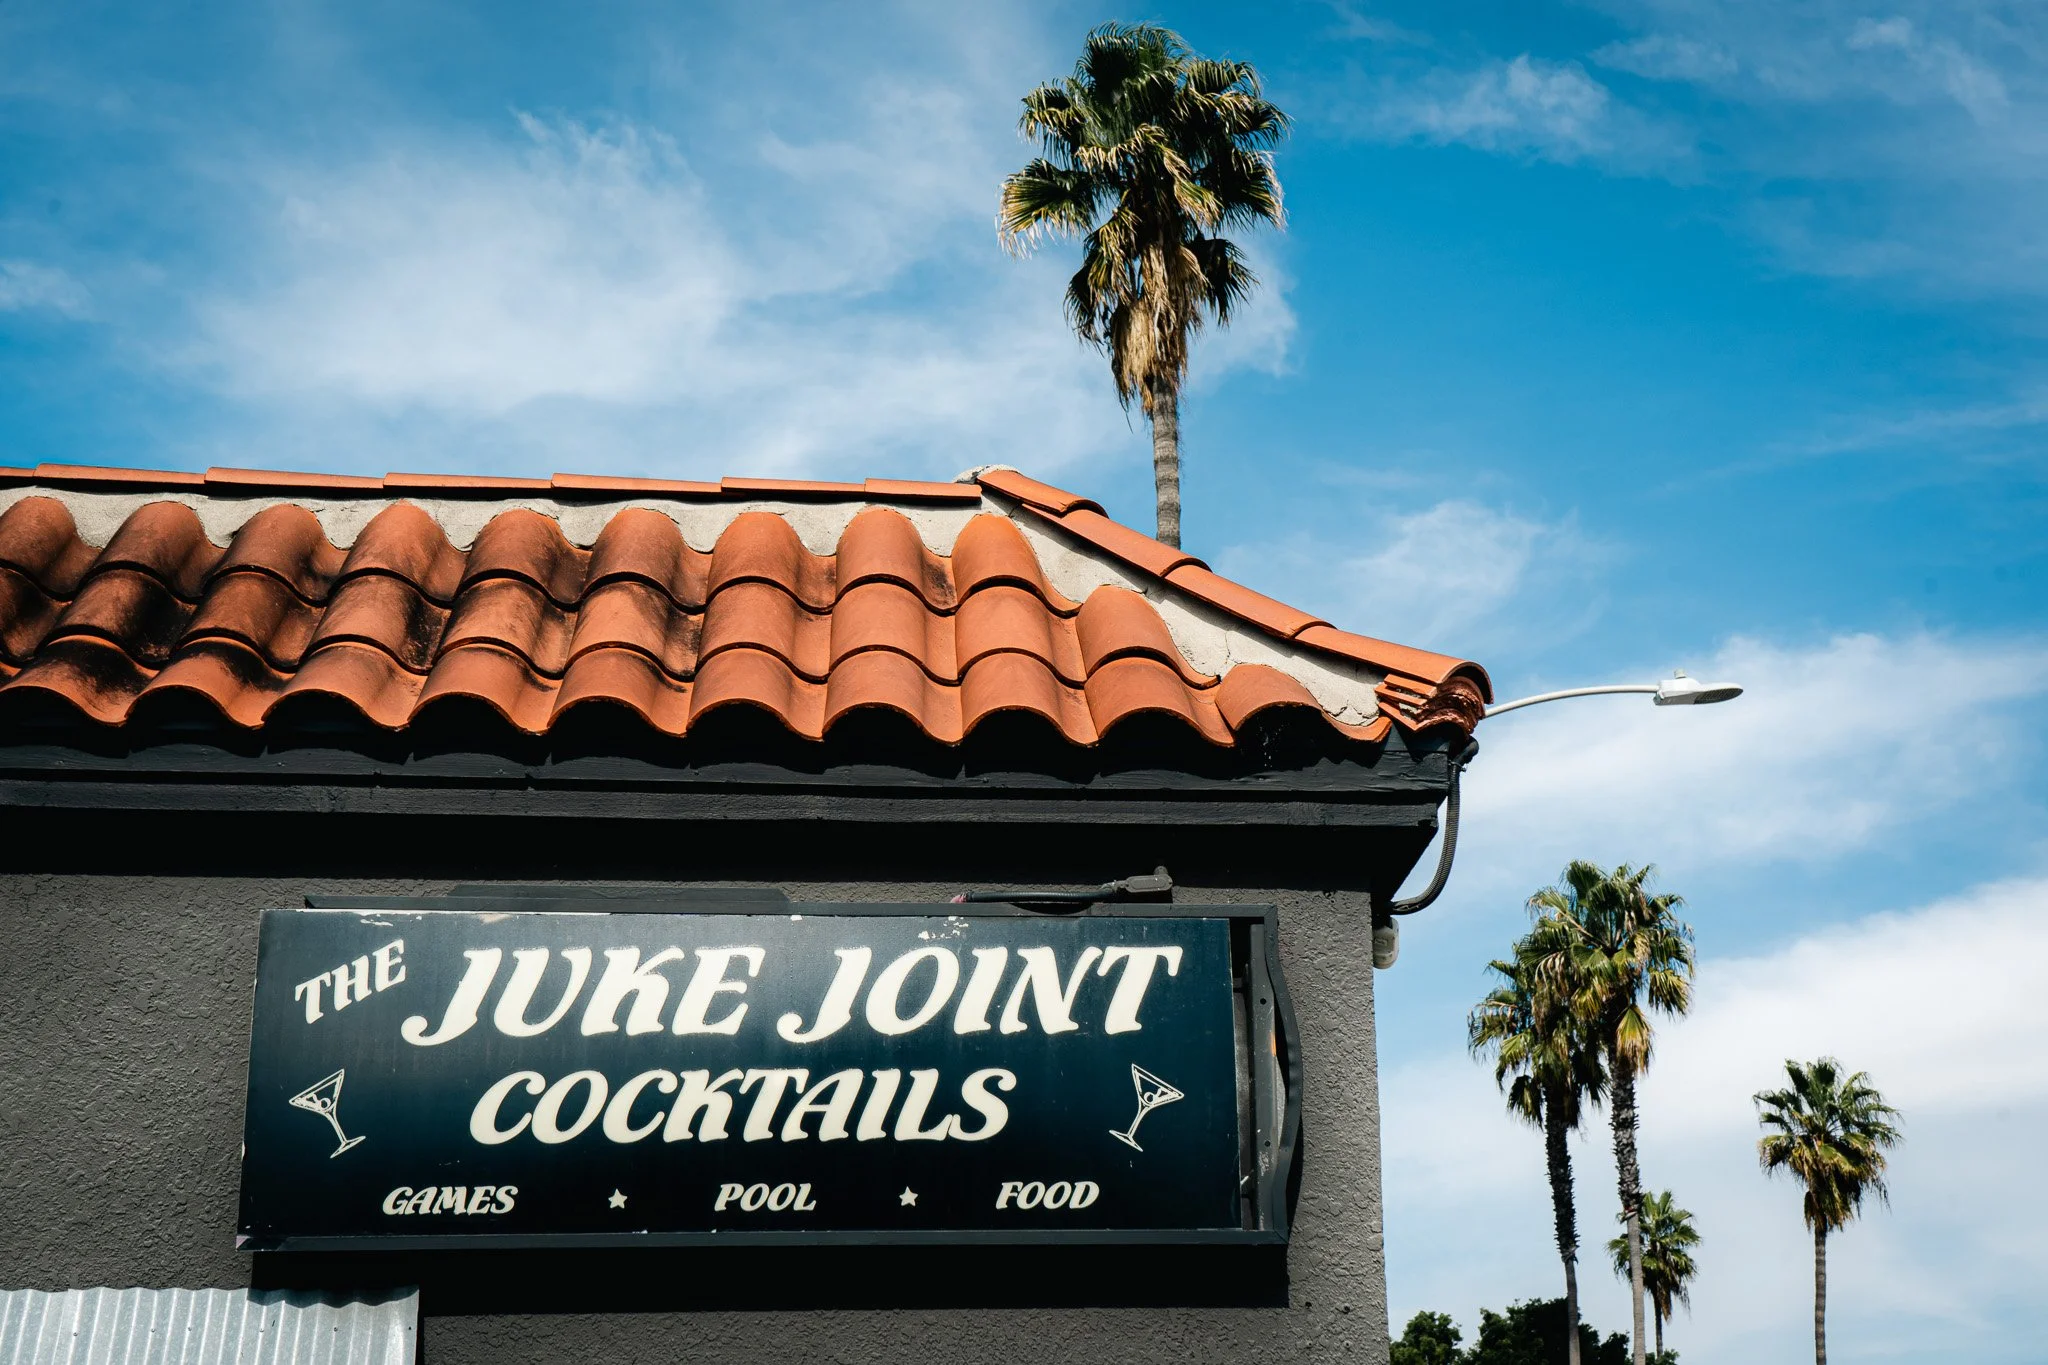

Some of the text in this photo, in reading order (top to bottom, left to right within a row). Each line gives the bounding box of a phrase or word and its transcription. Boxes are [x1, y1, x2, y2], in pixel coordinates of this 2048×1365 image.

[295, 938, 1184, 1046] THE JUKE JOINT
[469, 1068, 1017, 1145] COCKTAILS
[382, 1181, 1100, 1215] GAMES POOL FOOD
